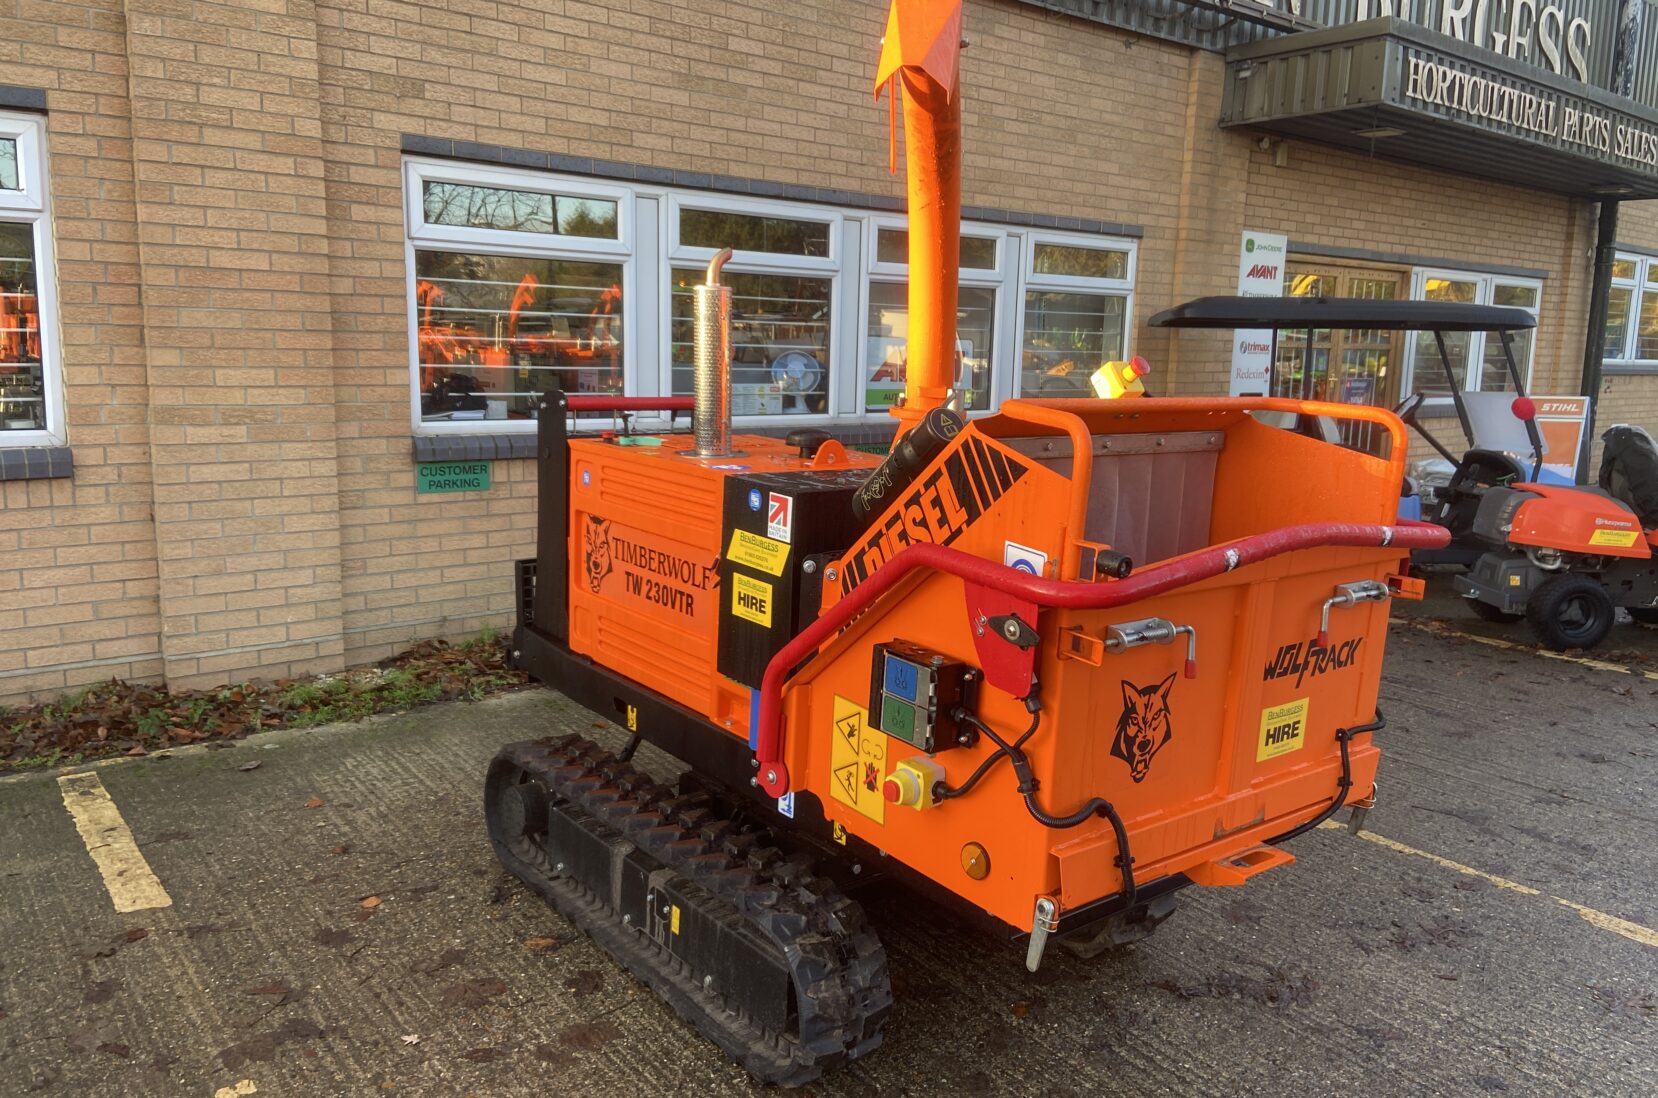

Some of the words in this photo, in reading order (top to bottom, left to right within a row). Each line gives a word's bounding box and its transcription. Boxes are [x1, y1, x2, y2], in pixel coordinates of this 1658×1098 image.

[1406, 57, 1557, 136] HORTICULTURAL
[1615, 124, 1657, 165] SALES
[1247, 264, 1278, 280] AVANT
[1247, 342, 1270, 352] trimax
[1541, 403, 1580, 412] STIHL
[420, 464, 488, 477] CUSTOMER
[428, 477, 481, 490] PARKING
[612, 536, 712, 591] TIMBERWOLF
[625, 570, 643, 597] TW
[645, 578, 694, 617] 230VTR
[738, 590, 766, 614] HIRE
[1264, 720, 1301, 747] HIRE
